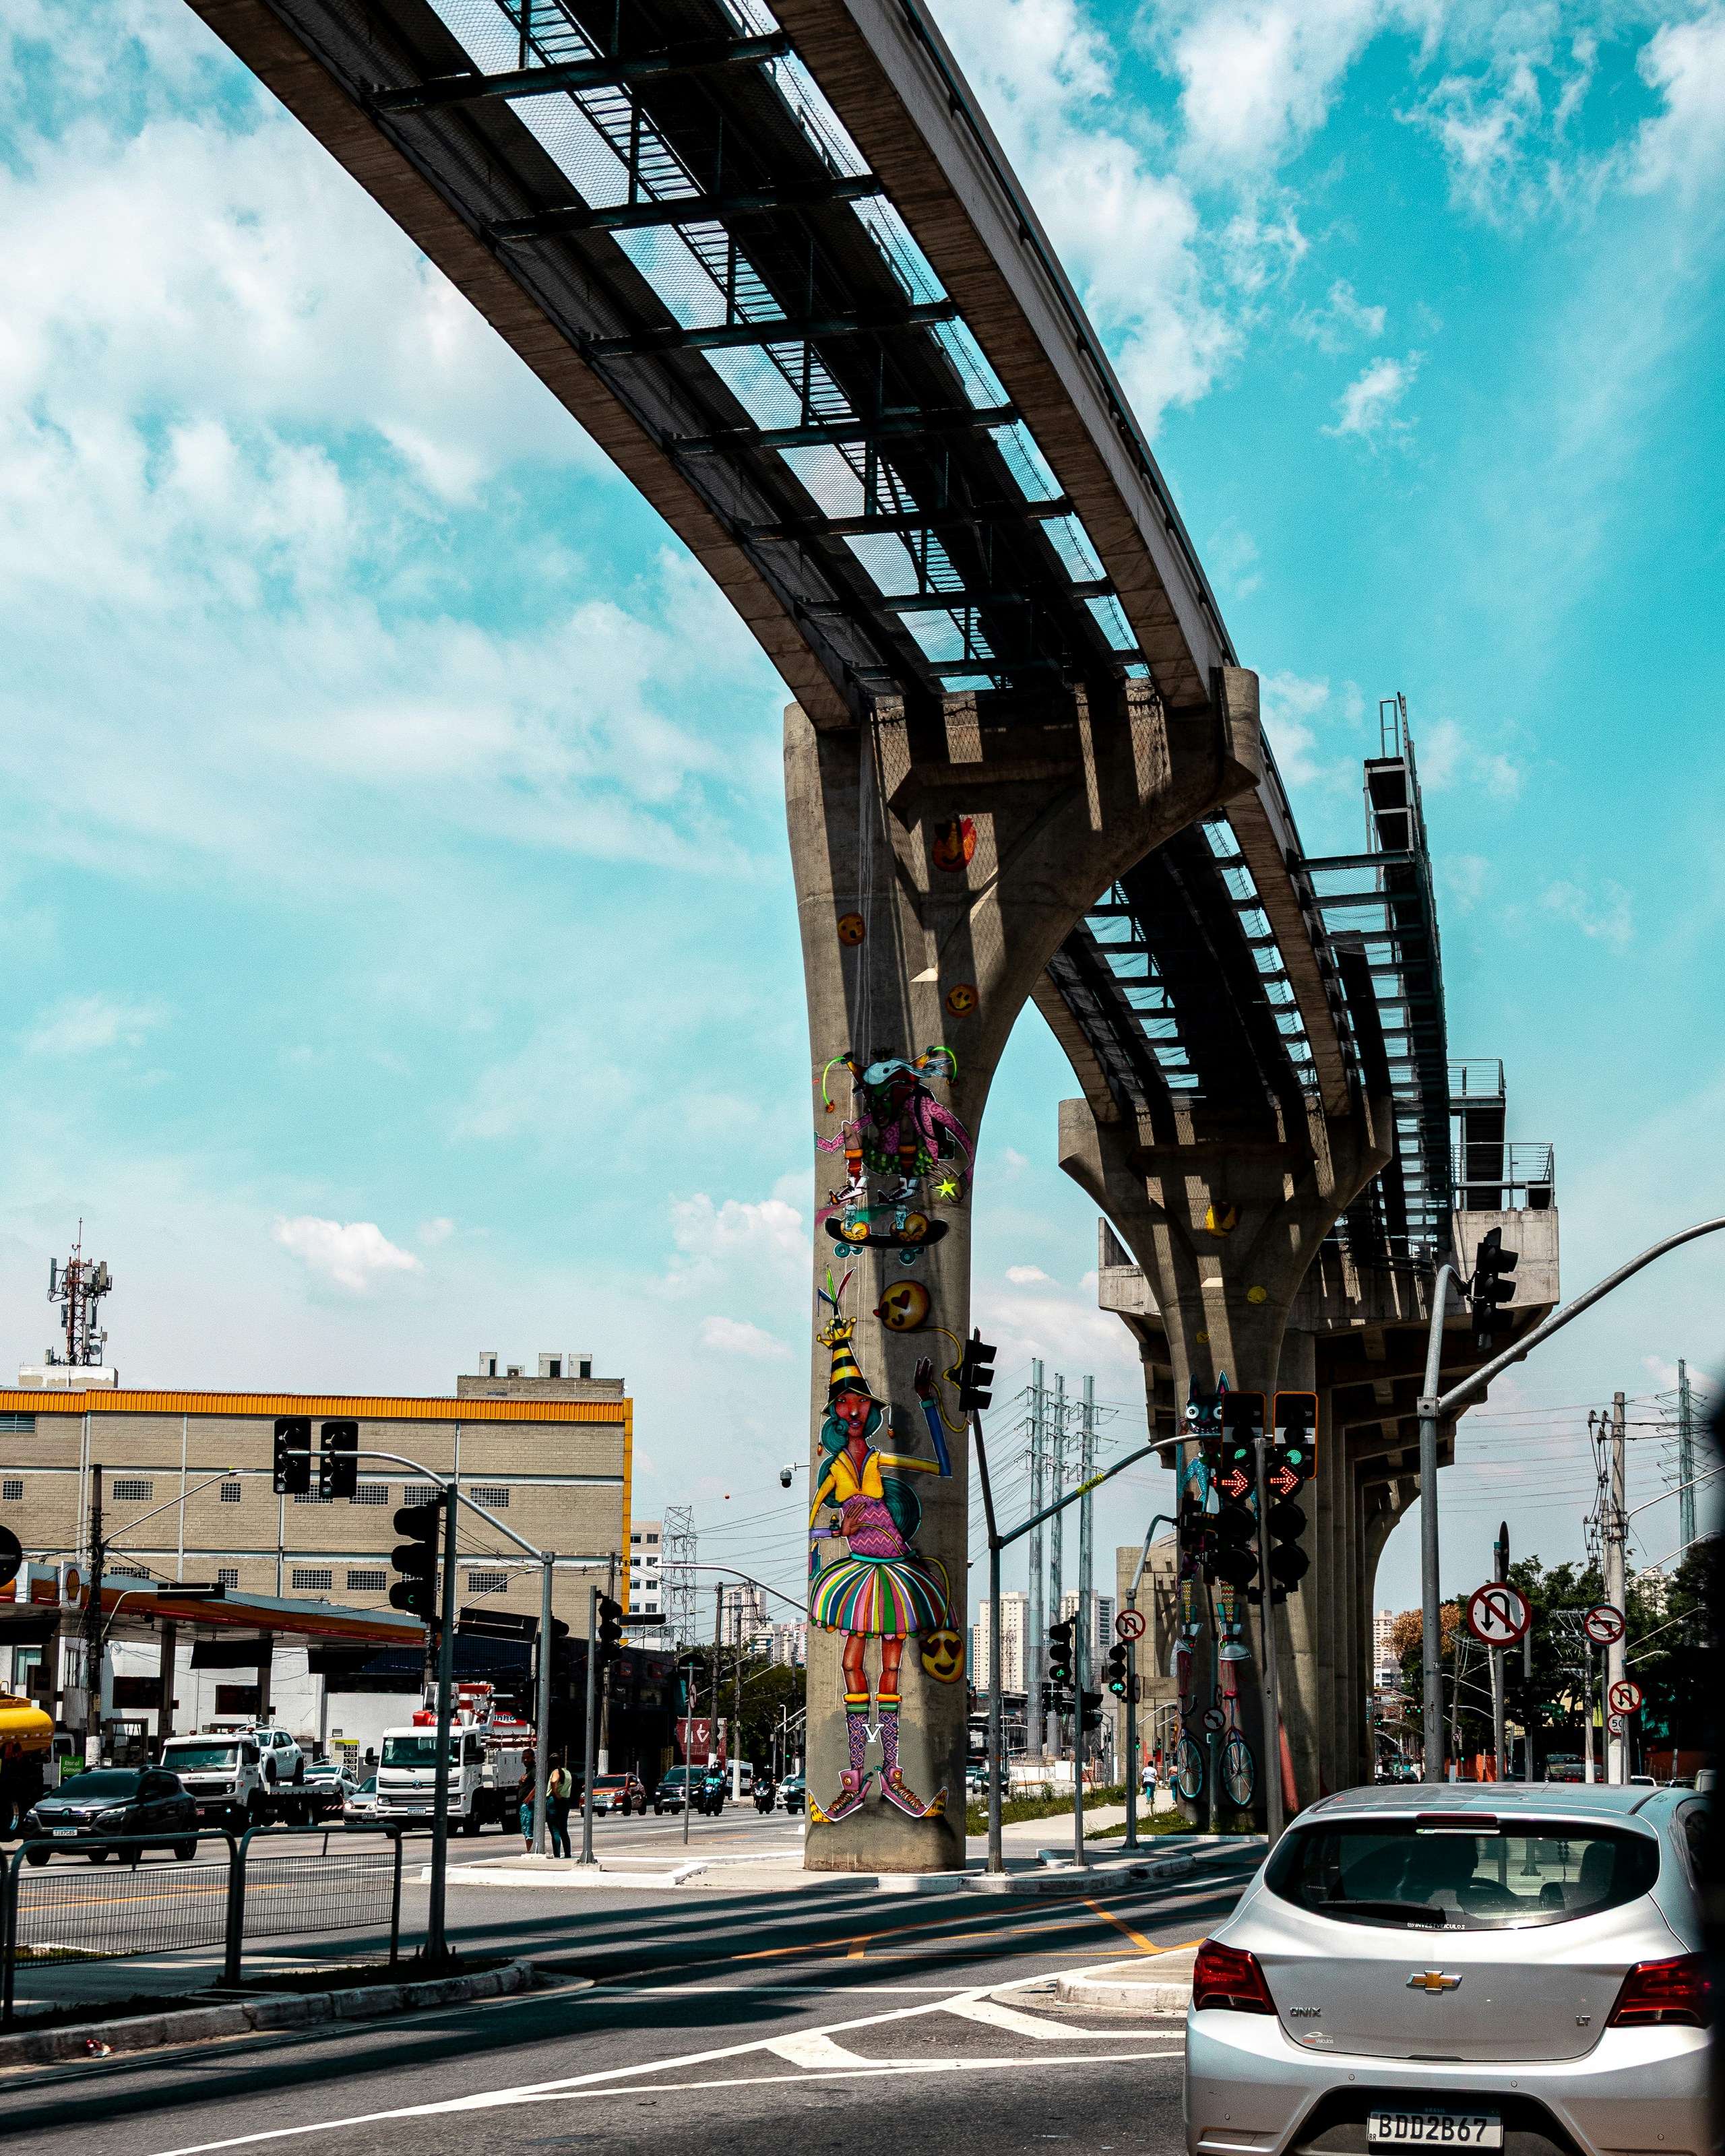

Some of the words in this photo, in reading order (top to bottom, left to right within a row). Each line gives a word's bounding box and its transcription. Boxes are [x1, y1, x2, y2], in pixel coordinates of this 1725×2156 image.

[1085, 1476, 1102, 1490] 4480
[1290, 2006, 1321, 2018] ONIX
[1575, 2015, 1591, 2027] LT
[1379, 2114, 1487, 2143] BDD2B67
[1369, 2133, 1377, 2141] BR
